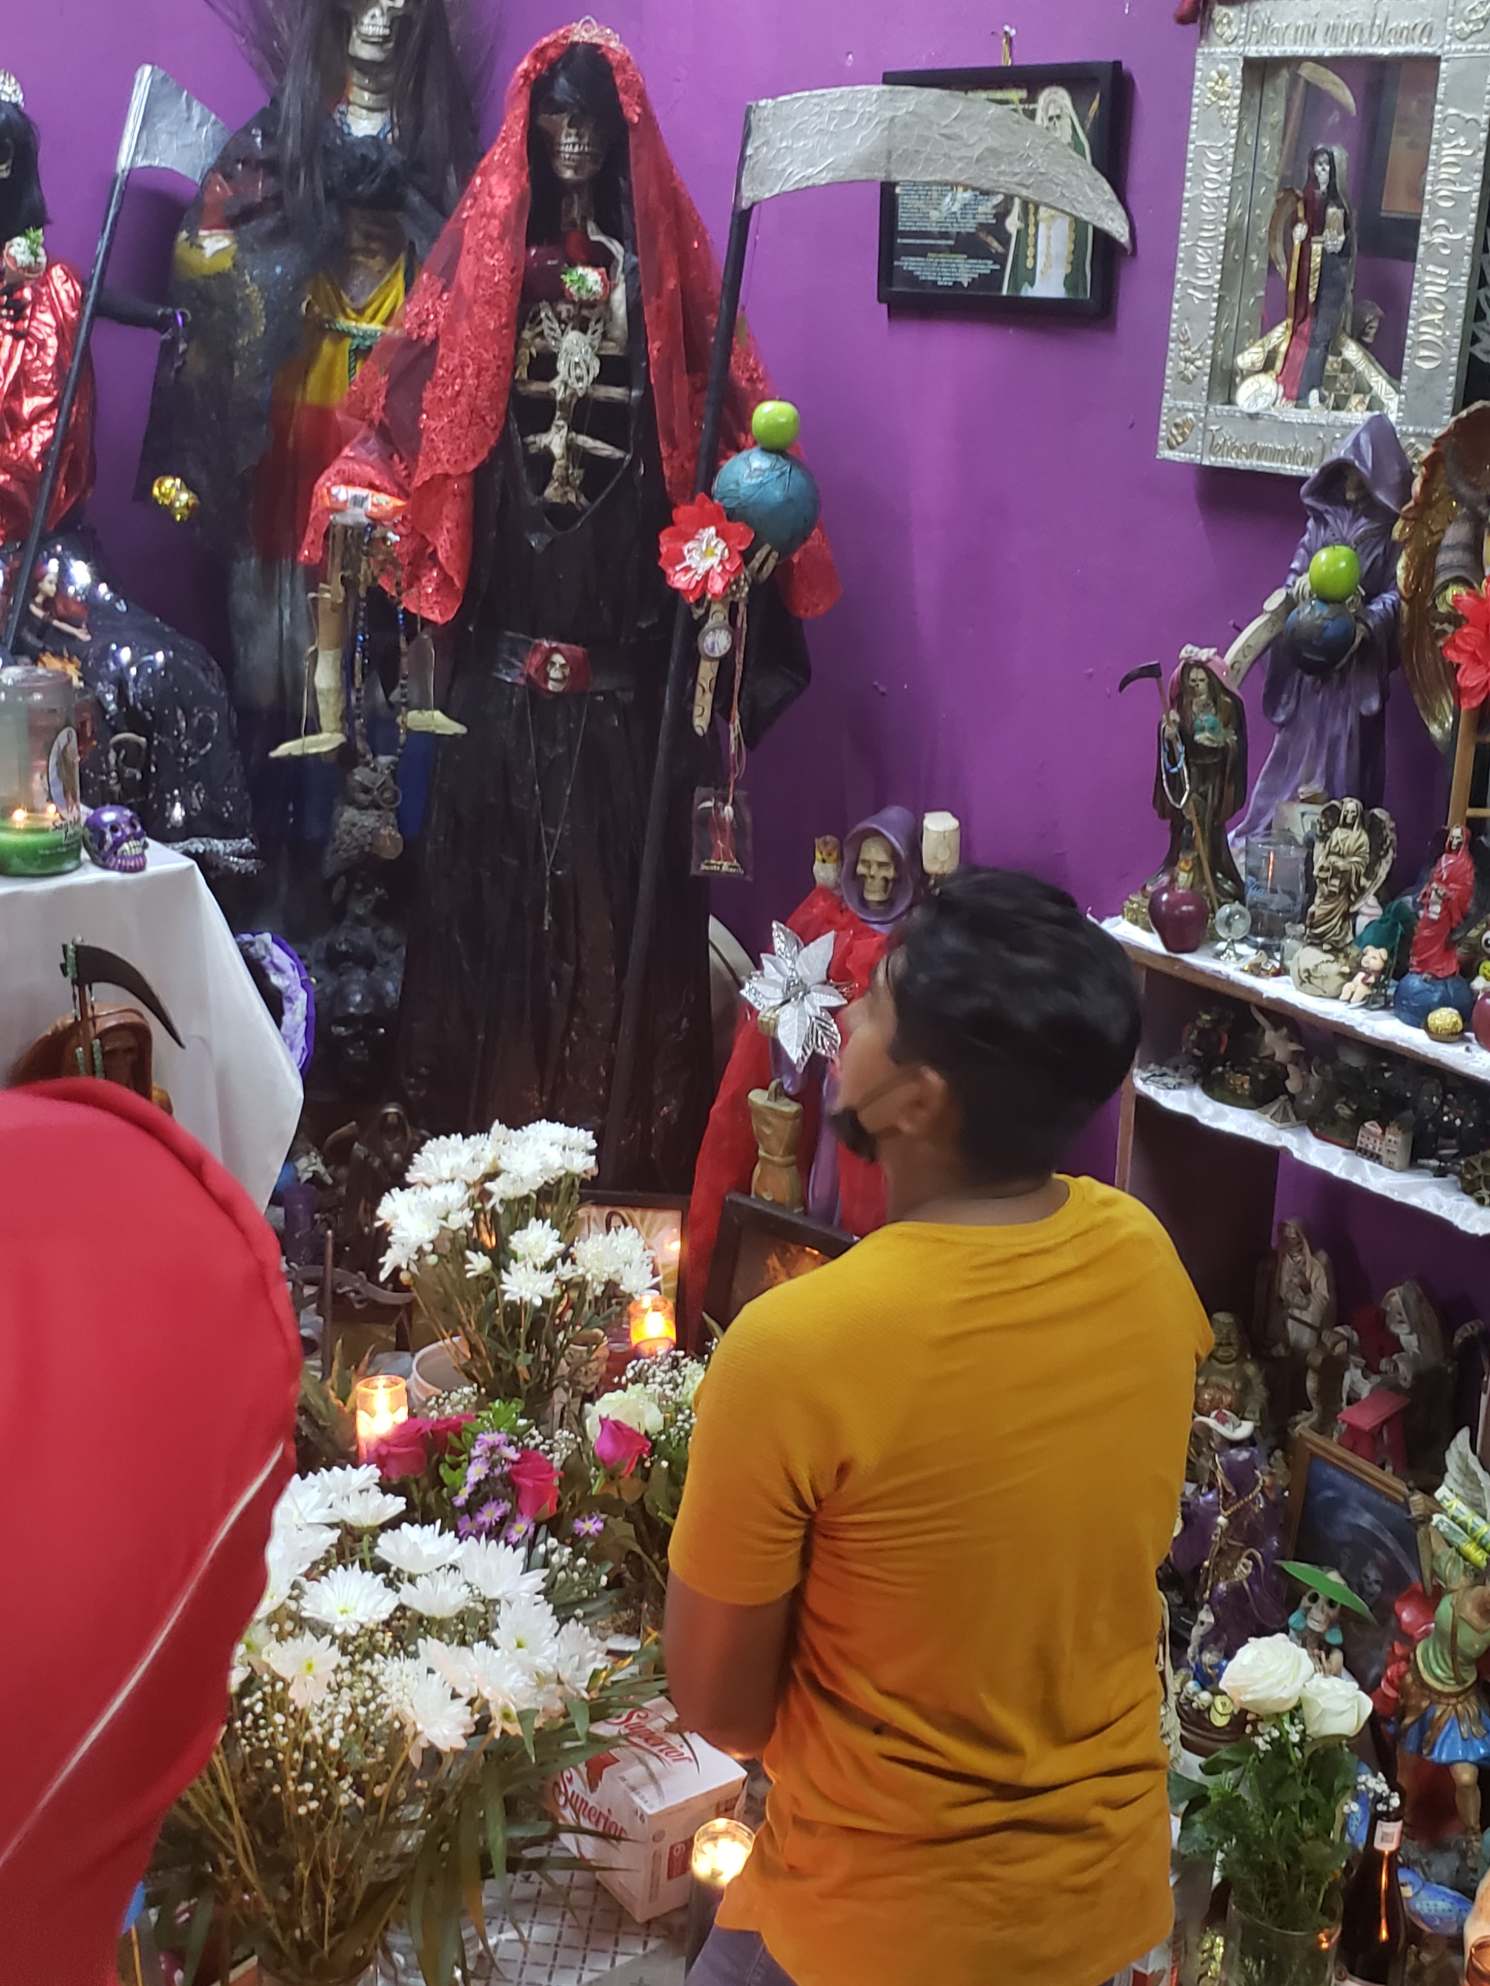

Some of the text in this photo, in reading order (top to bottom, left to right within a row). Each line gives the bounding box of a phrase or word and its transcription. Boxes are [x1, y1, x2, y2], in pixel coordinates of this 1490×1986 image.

[1369, 1, 1436, 46] blanca
[1422, 217, 1468, 255] de
[604, 1707, 693, 1766] Superior
